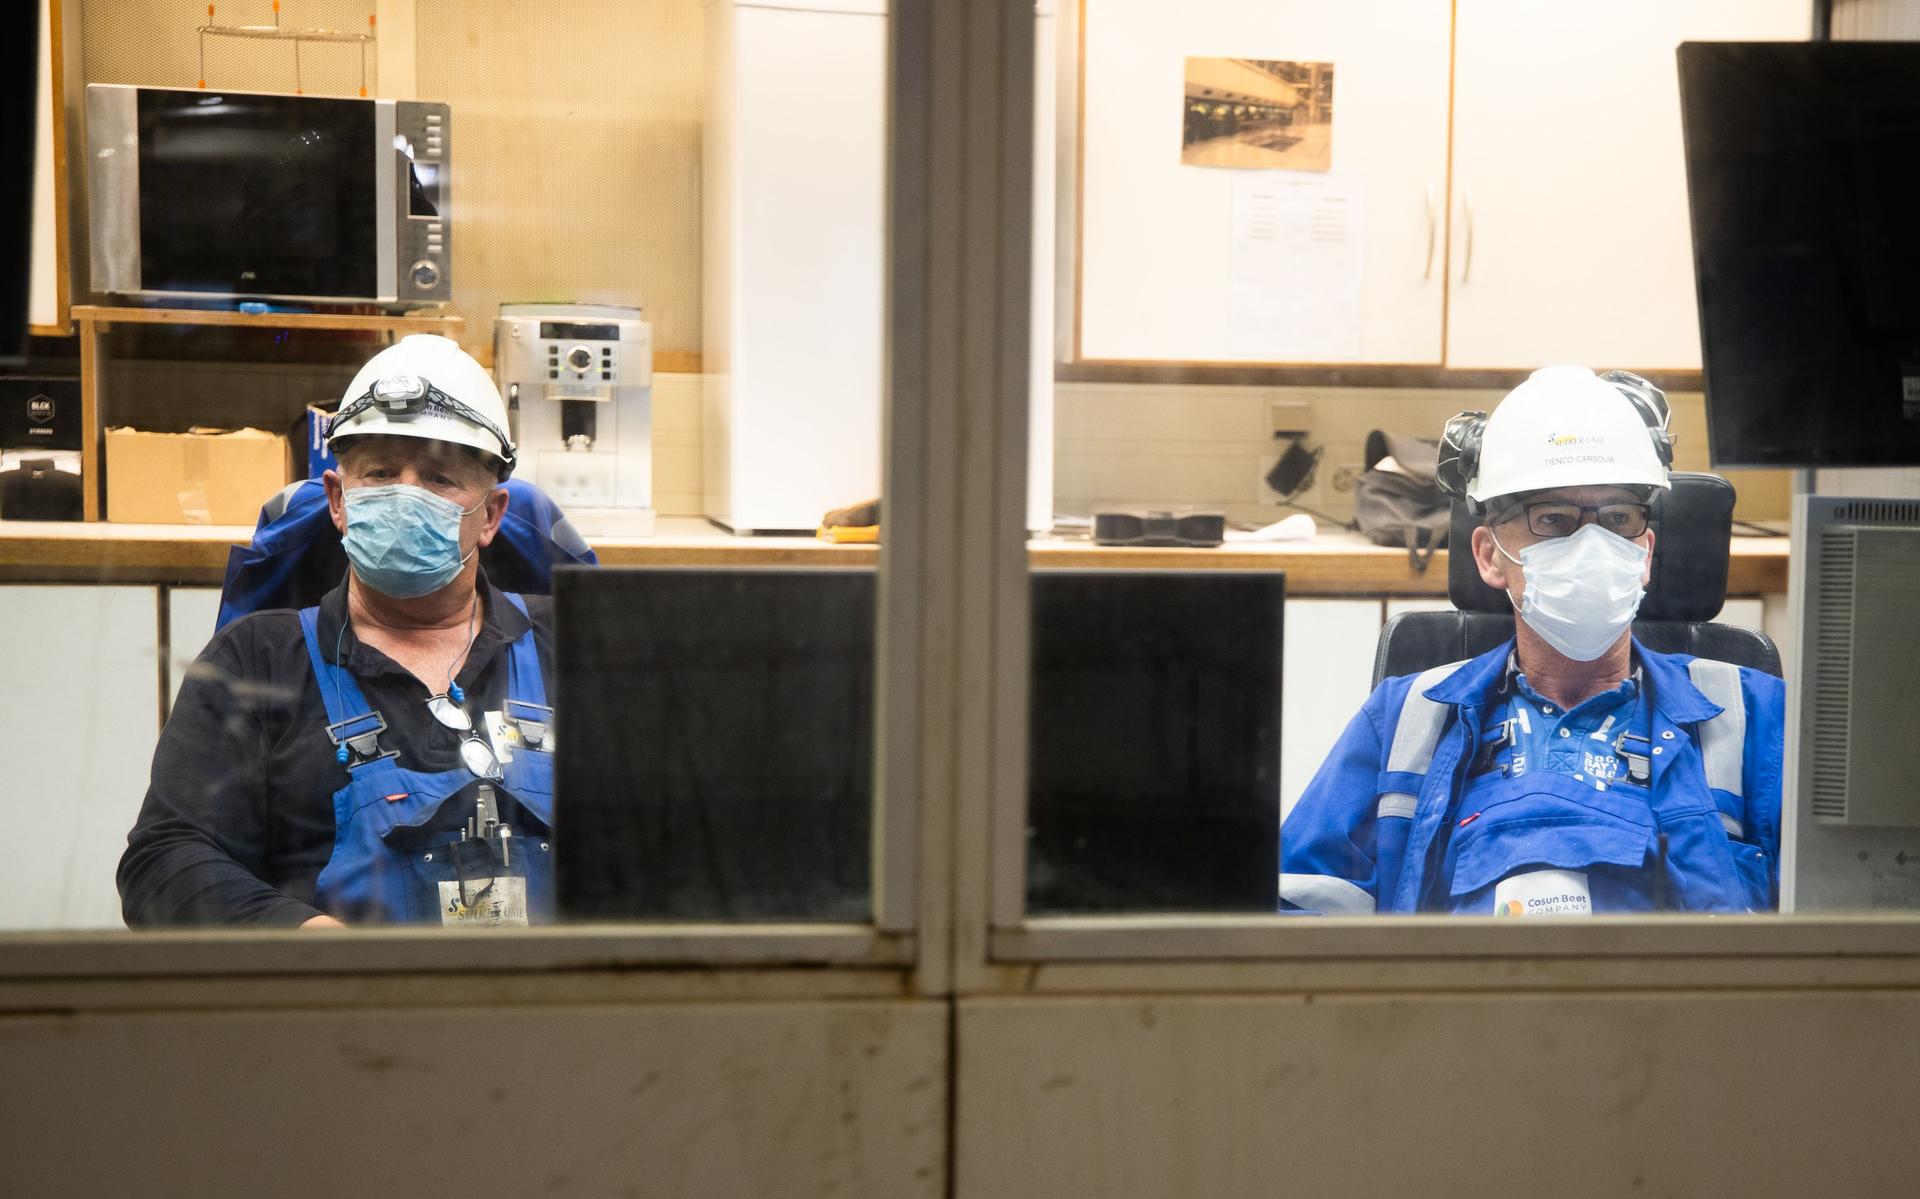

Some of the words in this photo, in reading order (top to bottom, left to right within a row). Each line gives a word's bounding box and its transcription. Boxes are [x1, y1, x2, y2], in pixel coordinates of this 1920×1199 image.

[1544, 456, 1575, 466] TIENCO
[1527, 896, 1559, 908] Cosun
[1561, 895, 1587, 904] Beet
[1528, 904, 1588, 917] COMPANY
